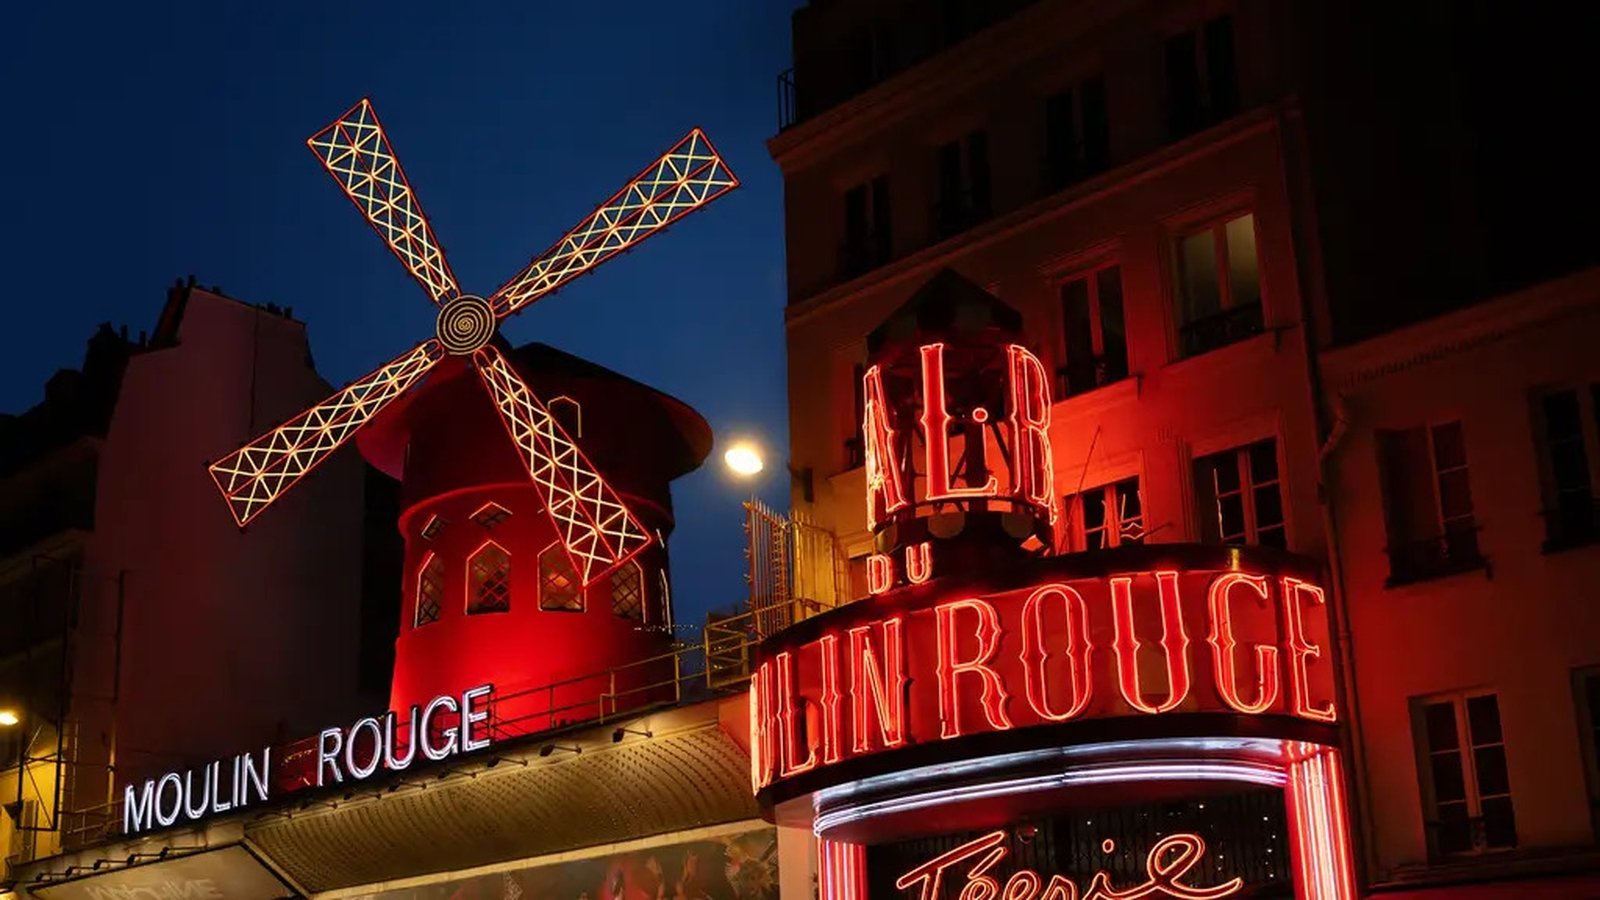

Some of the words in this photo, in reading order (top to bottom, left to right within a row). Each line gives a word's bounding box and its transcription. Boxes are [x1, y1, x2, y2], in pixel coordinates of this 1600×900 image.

[865, 541, 934, 595] DU
[933, 570, 1338, 741] ROUGE
[122, 745, 272, 835] MOULIN
[316, 683, 494, 787] ROUGE
